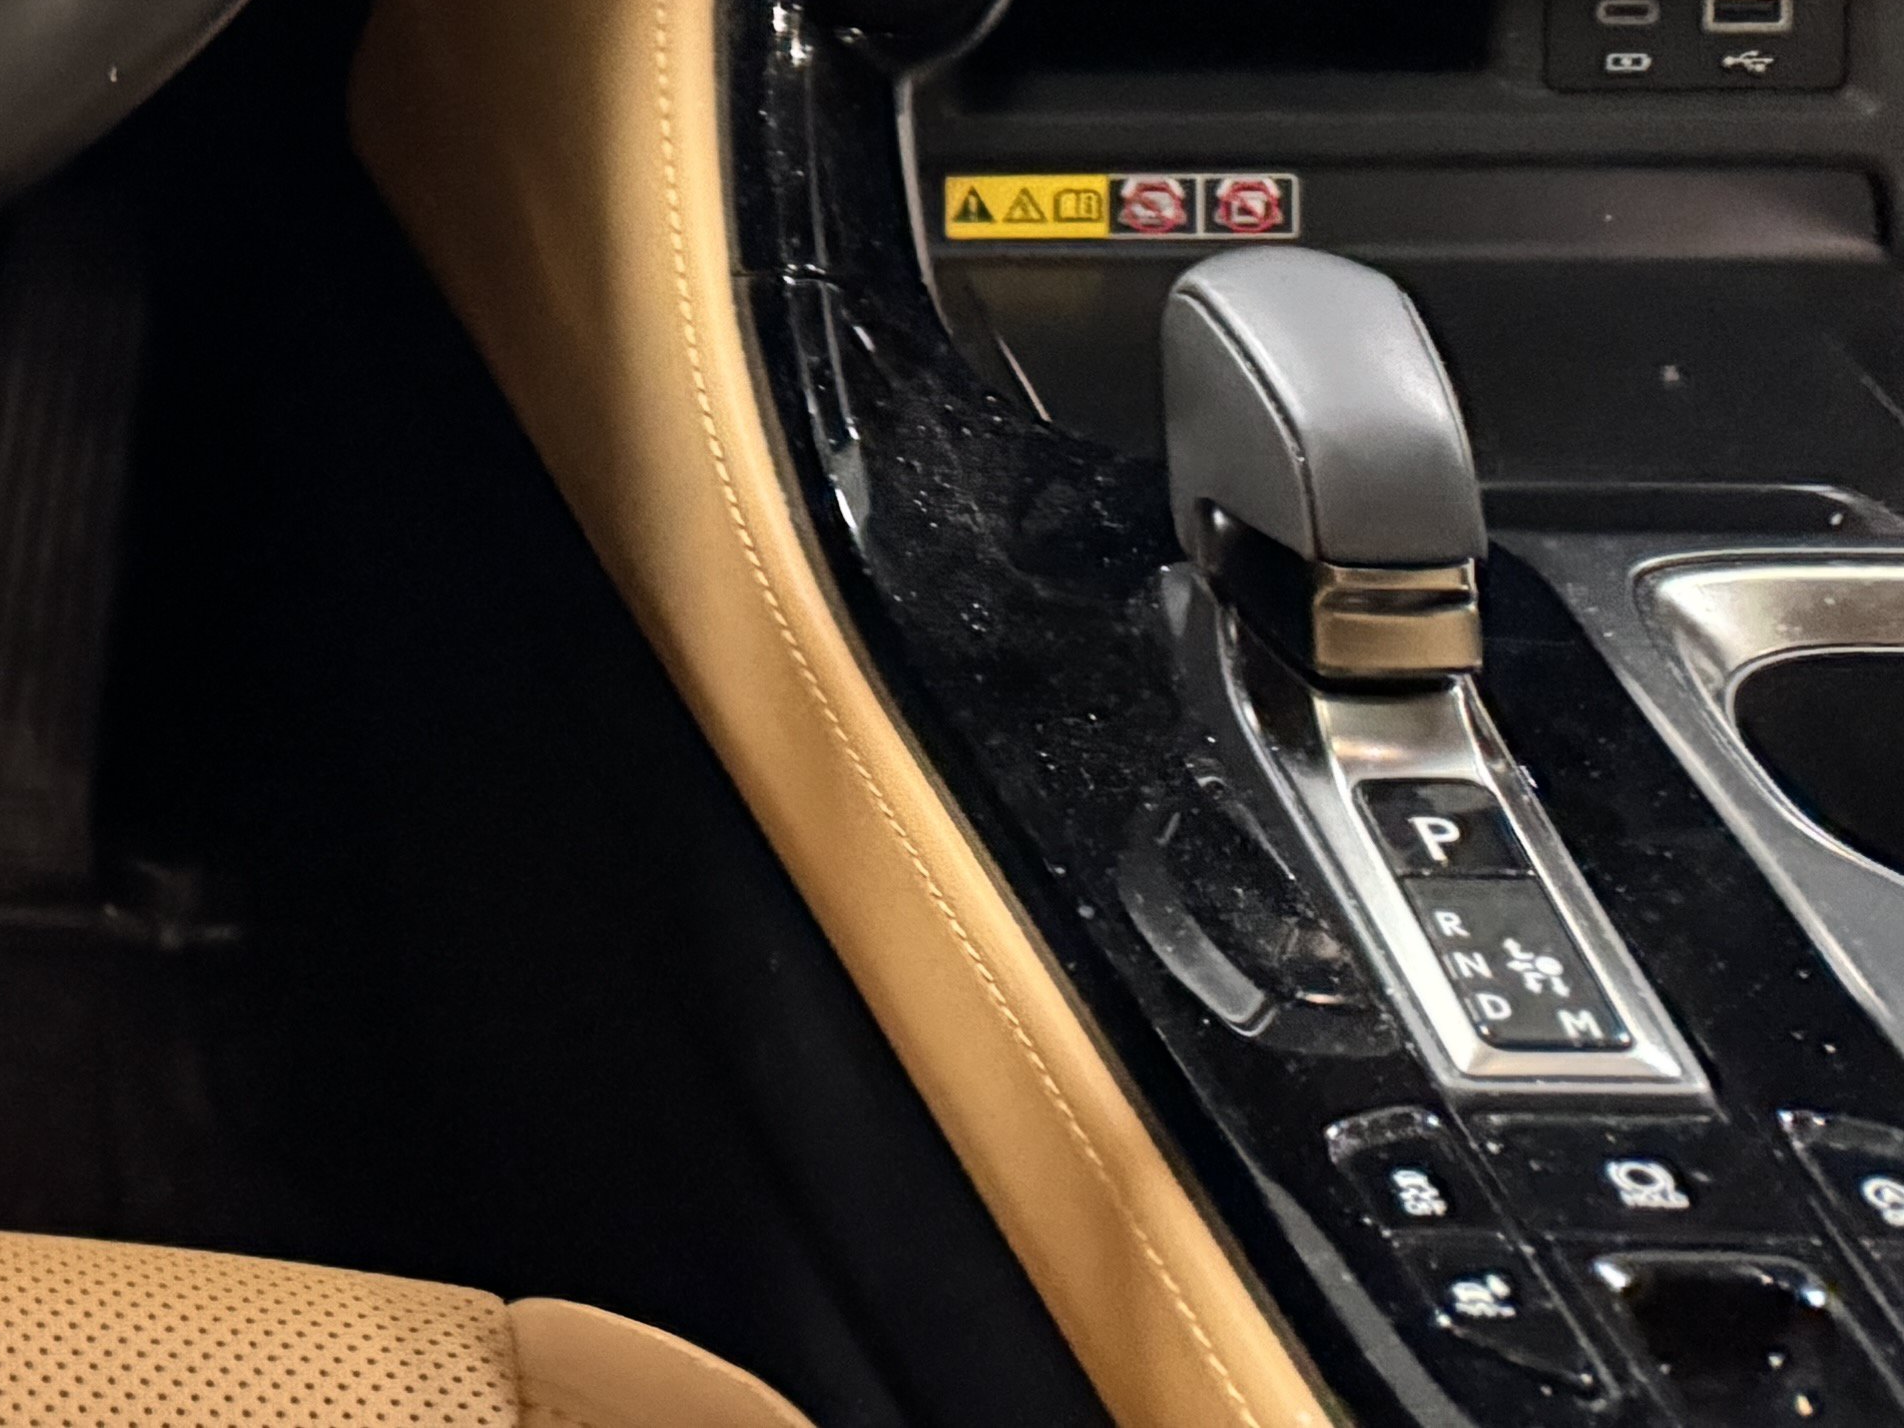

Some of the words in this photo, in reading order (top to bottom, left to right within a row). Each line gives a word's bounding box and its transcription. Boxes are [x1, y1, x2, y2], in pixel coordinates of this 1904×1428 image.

[1407, 816, 1460, 867] P
[1433, 910, 1471, 939] R
[1453, 951, 1493, 980] N
[1475, 991, 1513, 1021] D
[1556, 1008, 1604, 1040] M
